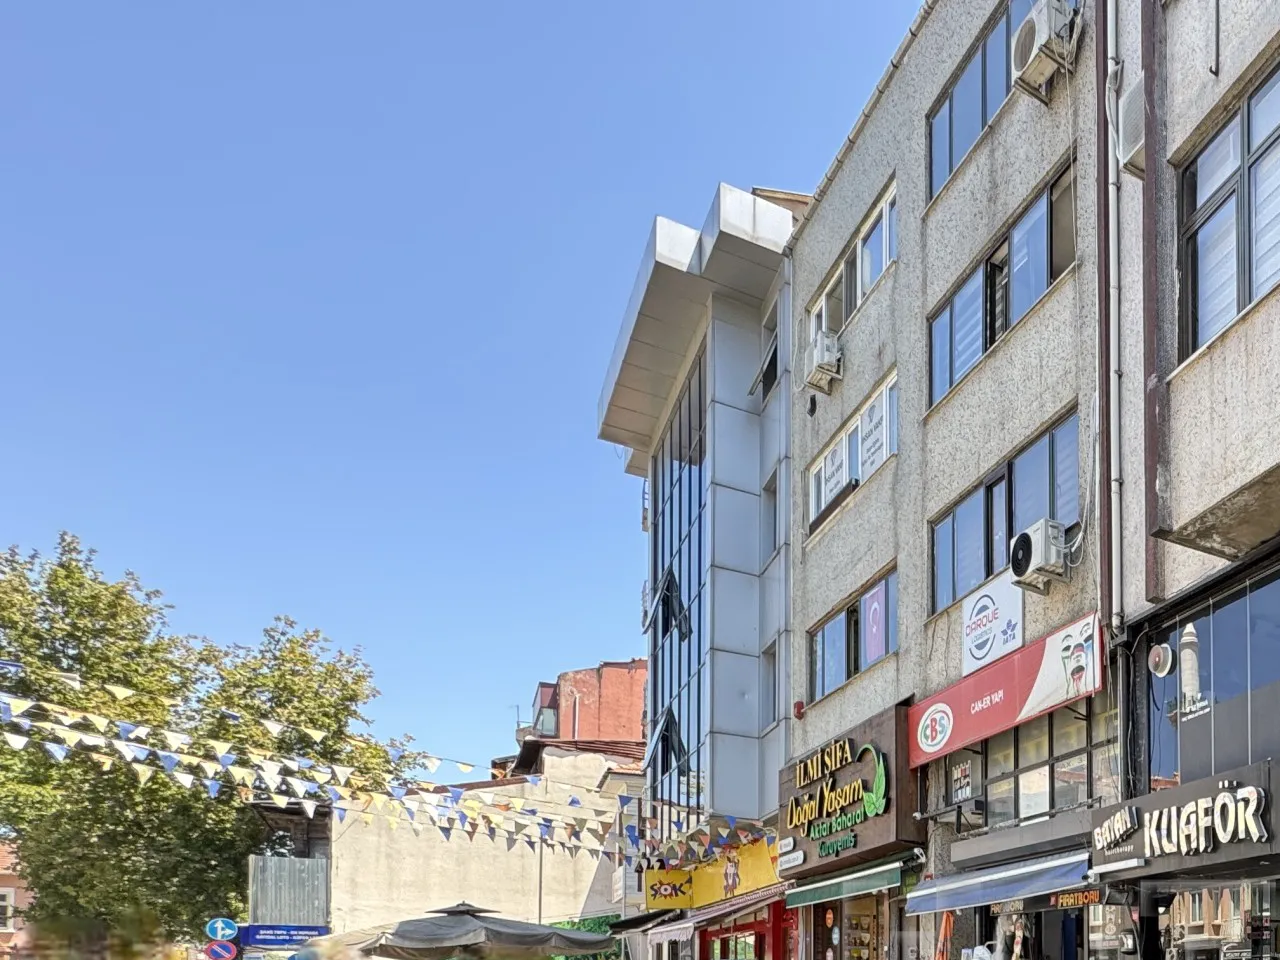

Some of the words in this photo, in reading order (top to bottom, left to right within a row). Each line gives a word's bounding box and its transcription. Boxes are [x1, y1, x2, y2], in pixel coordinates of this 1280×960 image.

[924, 716, 945, 743] CBS
[787, 786, 820, 837] Doğal
[823, 777, 864, 818] Yaşam
[1144, 781, 1267, 858] KUAFÖR
[810, 822, 831, 841] Aktar
[1059, 890, 1100, 907] FIRATBORU
